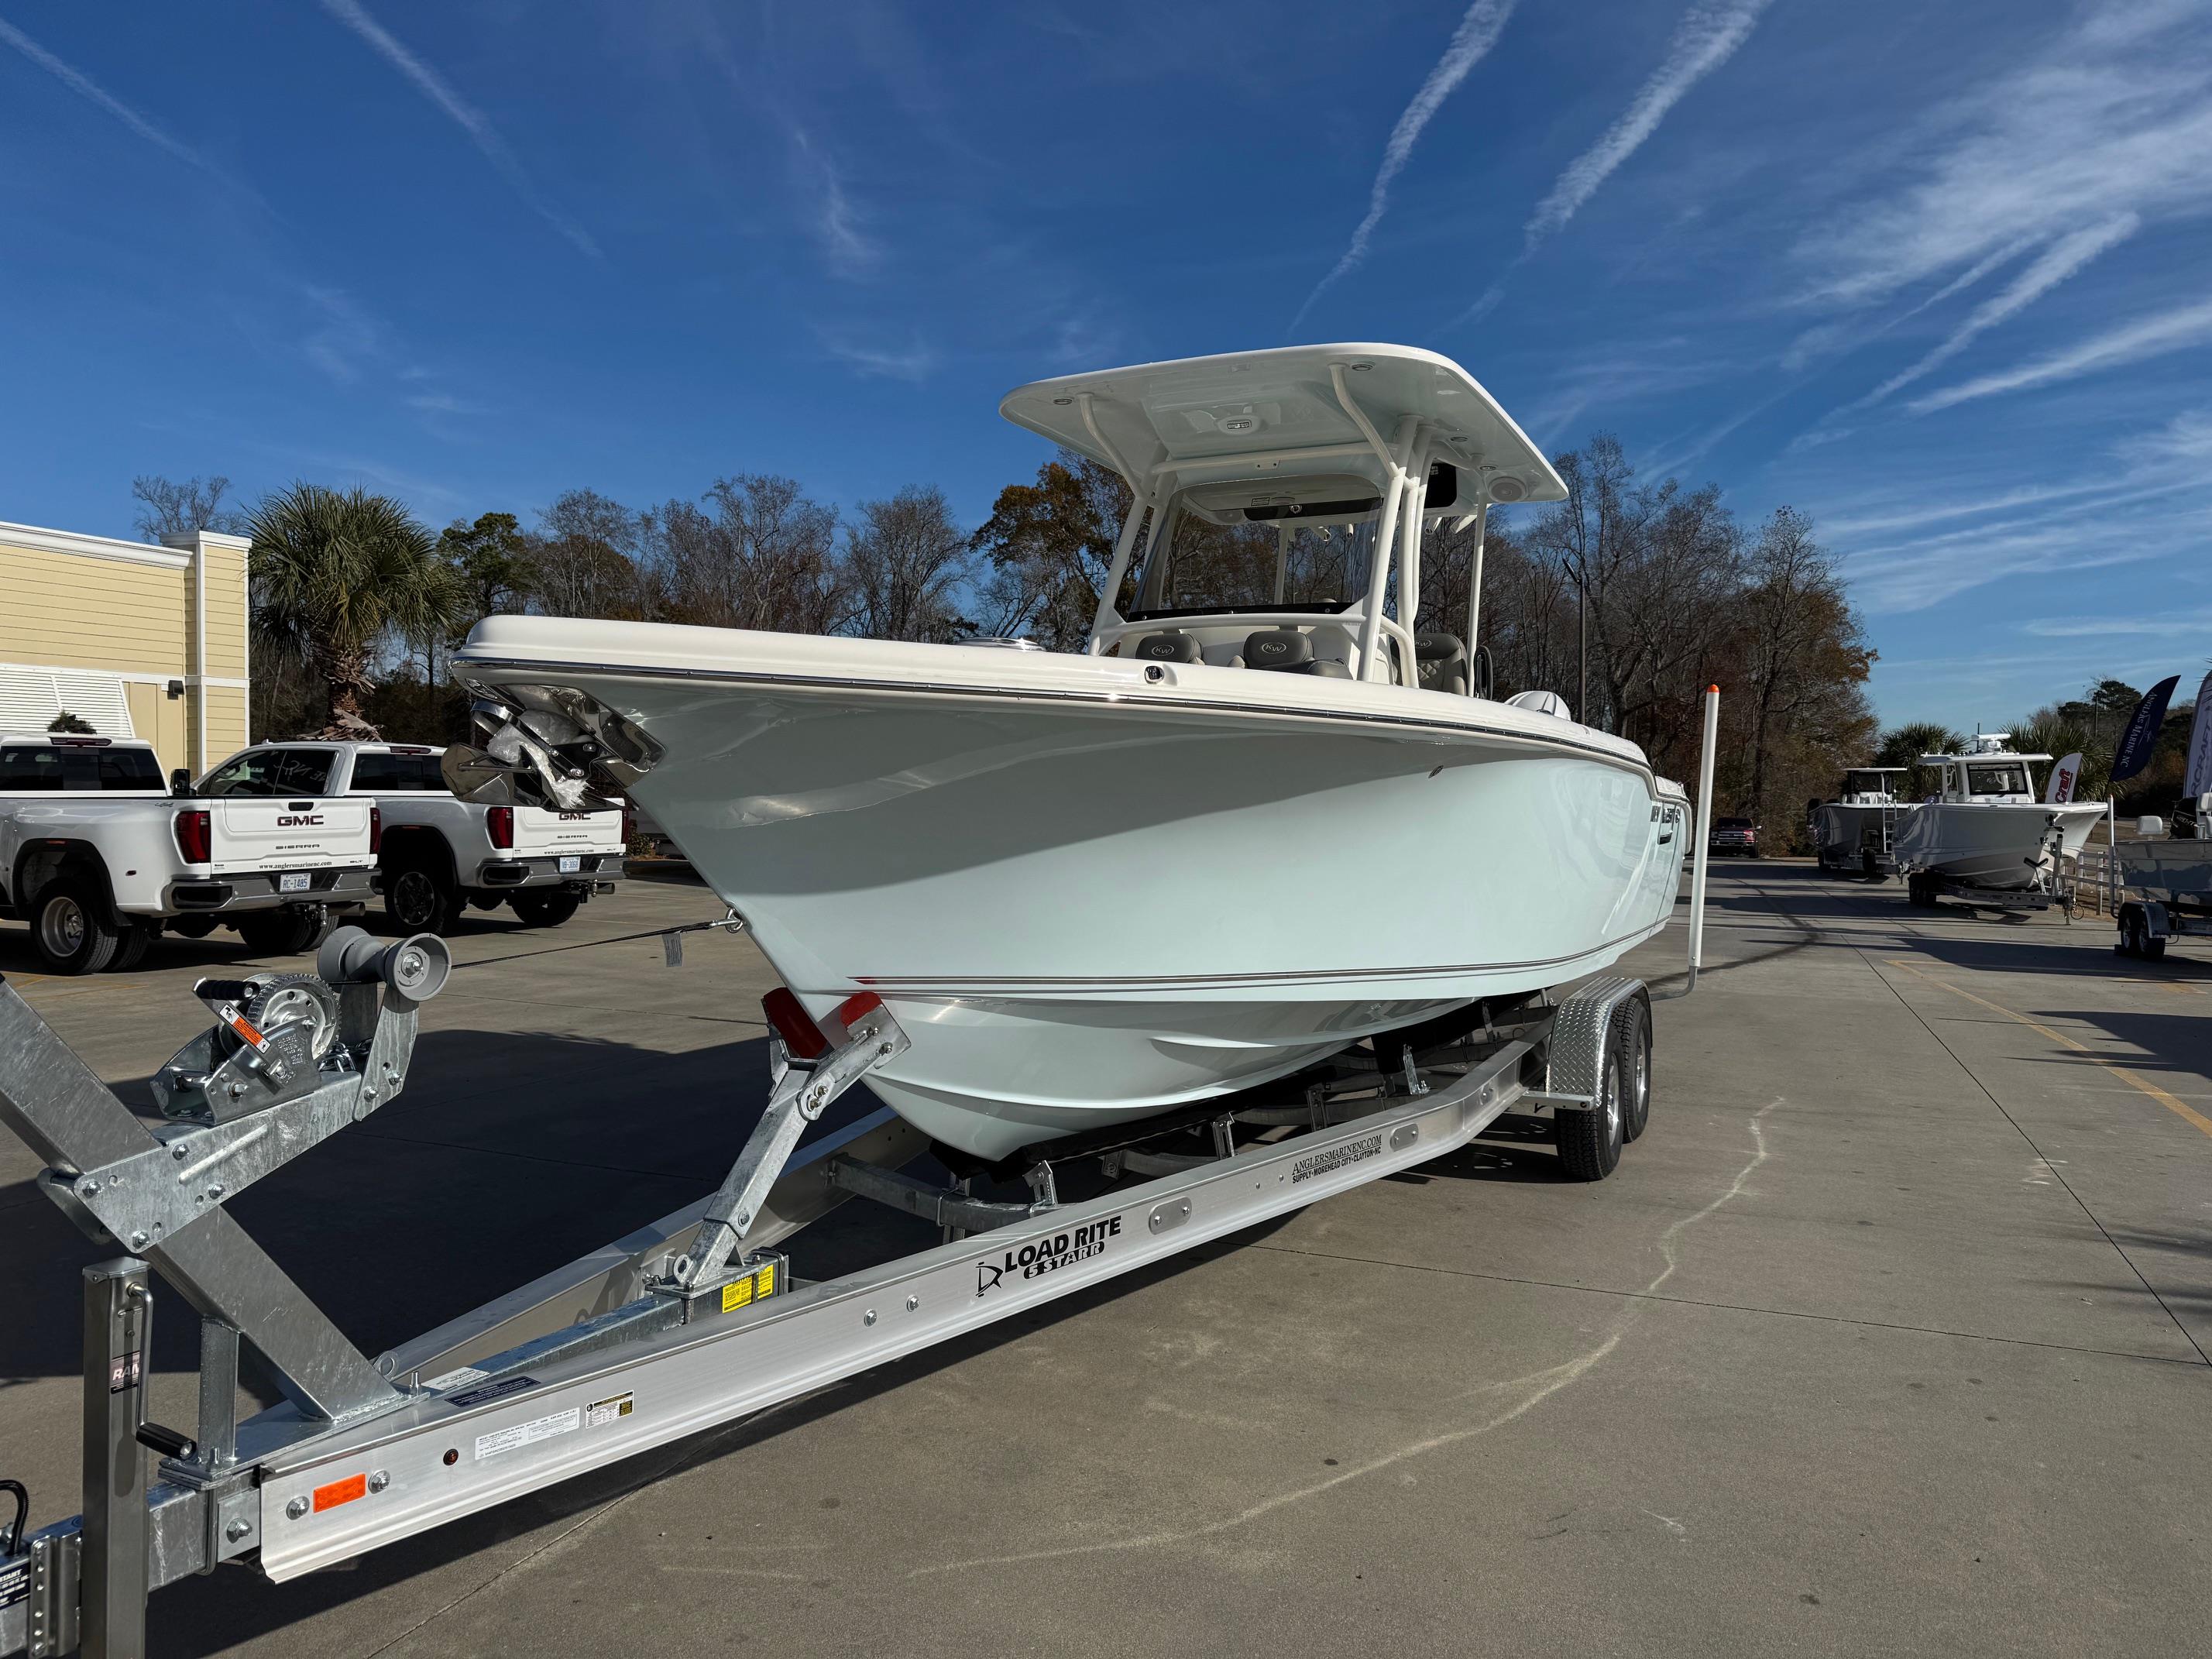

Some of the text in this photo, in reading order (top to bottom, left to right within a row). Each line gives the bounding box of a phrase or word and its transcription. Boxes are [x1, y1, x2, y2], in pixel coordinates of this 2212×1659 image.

[2124, 725, 2143, 755] MARINE
[2120, 755, 2131, 768] NC
[277, 815, 325, 826] GMC
[559, 812, 592, 821] GMC
[259, 860, 332, 869] www.anglersmarinenc.com
[1292, 1134, 1382, 1176] ANGLERSMARINENC.COM
[1005, 1215, 1121, 1273] LOAD RITE
[1029, 1265, 1038, 1278] 5
